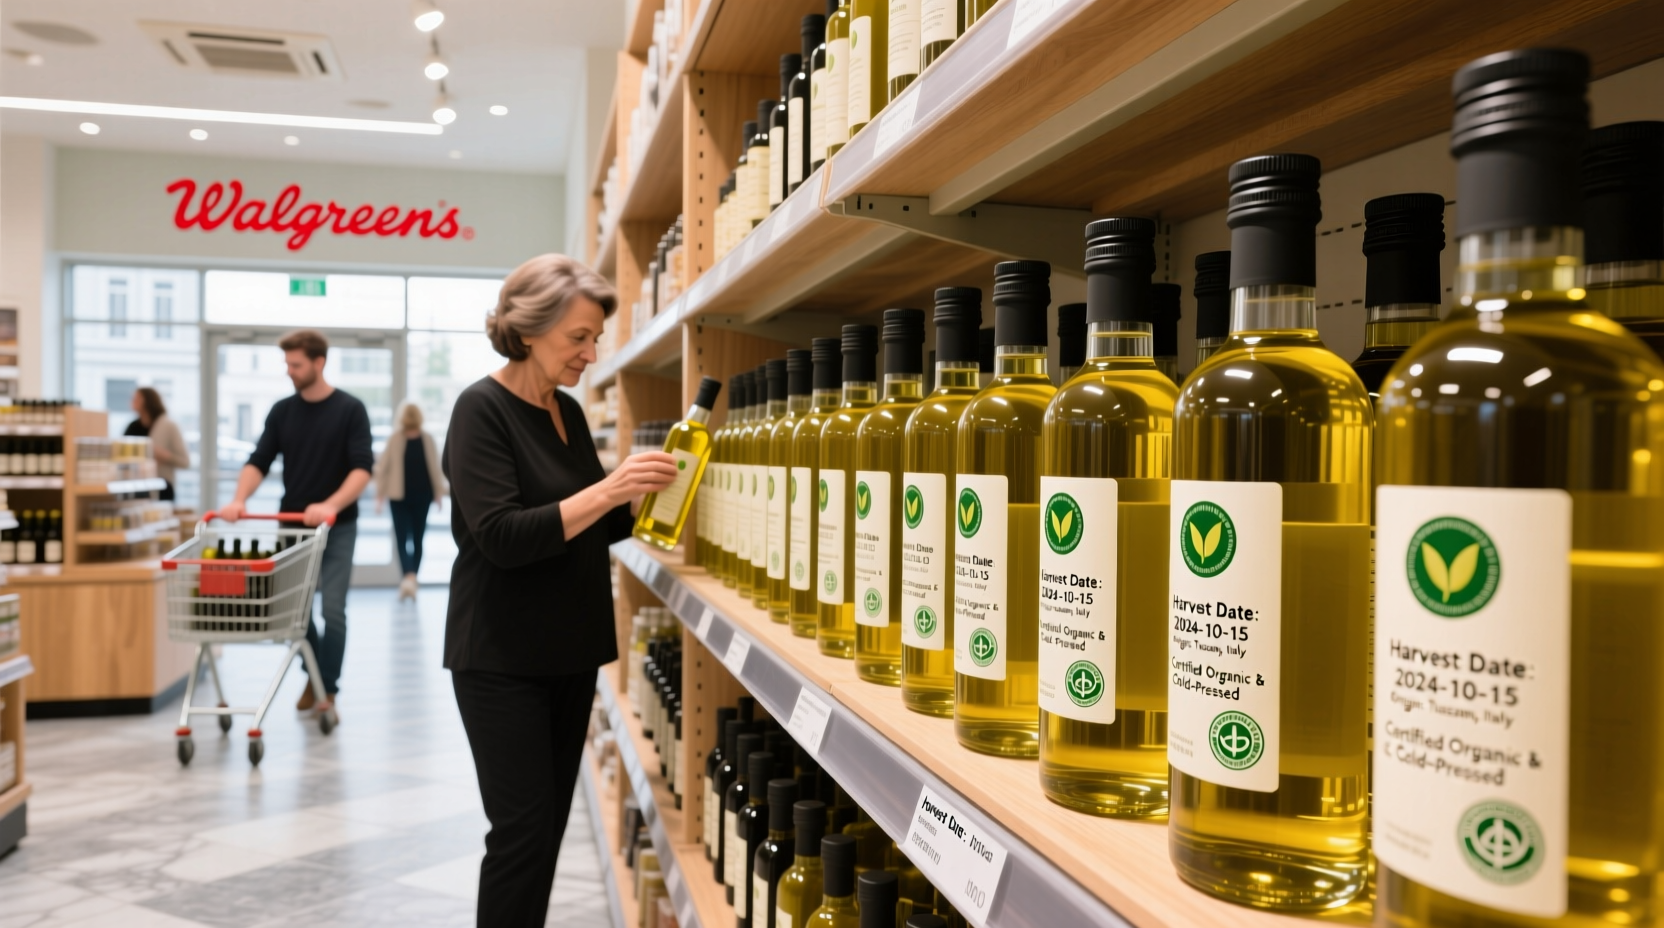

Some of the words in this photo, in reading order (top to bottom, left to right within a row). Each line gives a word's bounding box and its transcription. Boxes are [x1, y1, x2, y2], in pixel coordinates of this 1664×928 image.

[1070, 573, 1102, 589] Date:
[1216, 601, 1259, 621] Date:
[1174, 615, 1249, 642] 2024-10-15
[1390, 638, 1460, 670] Harvest
[1469, 652, 1535, 680] Date:
[1206, 665, 1251, 685] Organic
[1256, 673, 1265, 686] &
[1395, 668, 1519, 707] 2024-10-15
[1449, 738, 1522, 767] Organic
[1528, 751, 1541, 769] &
